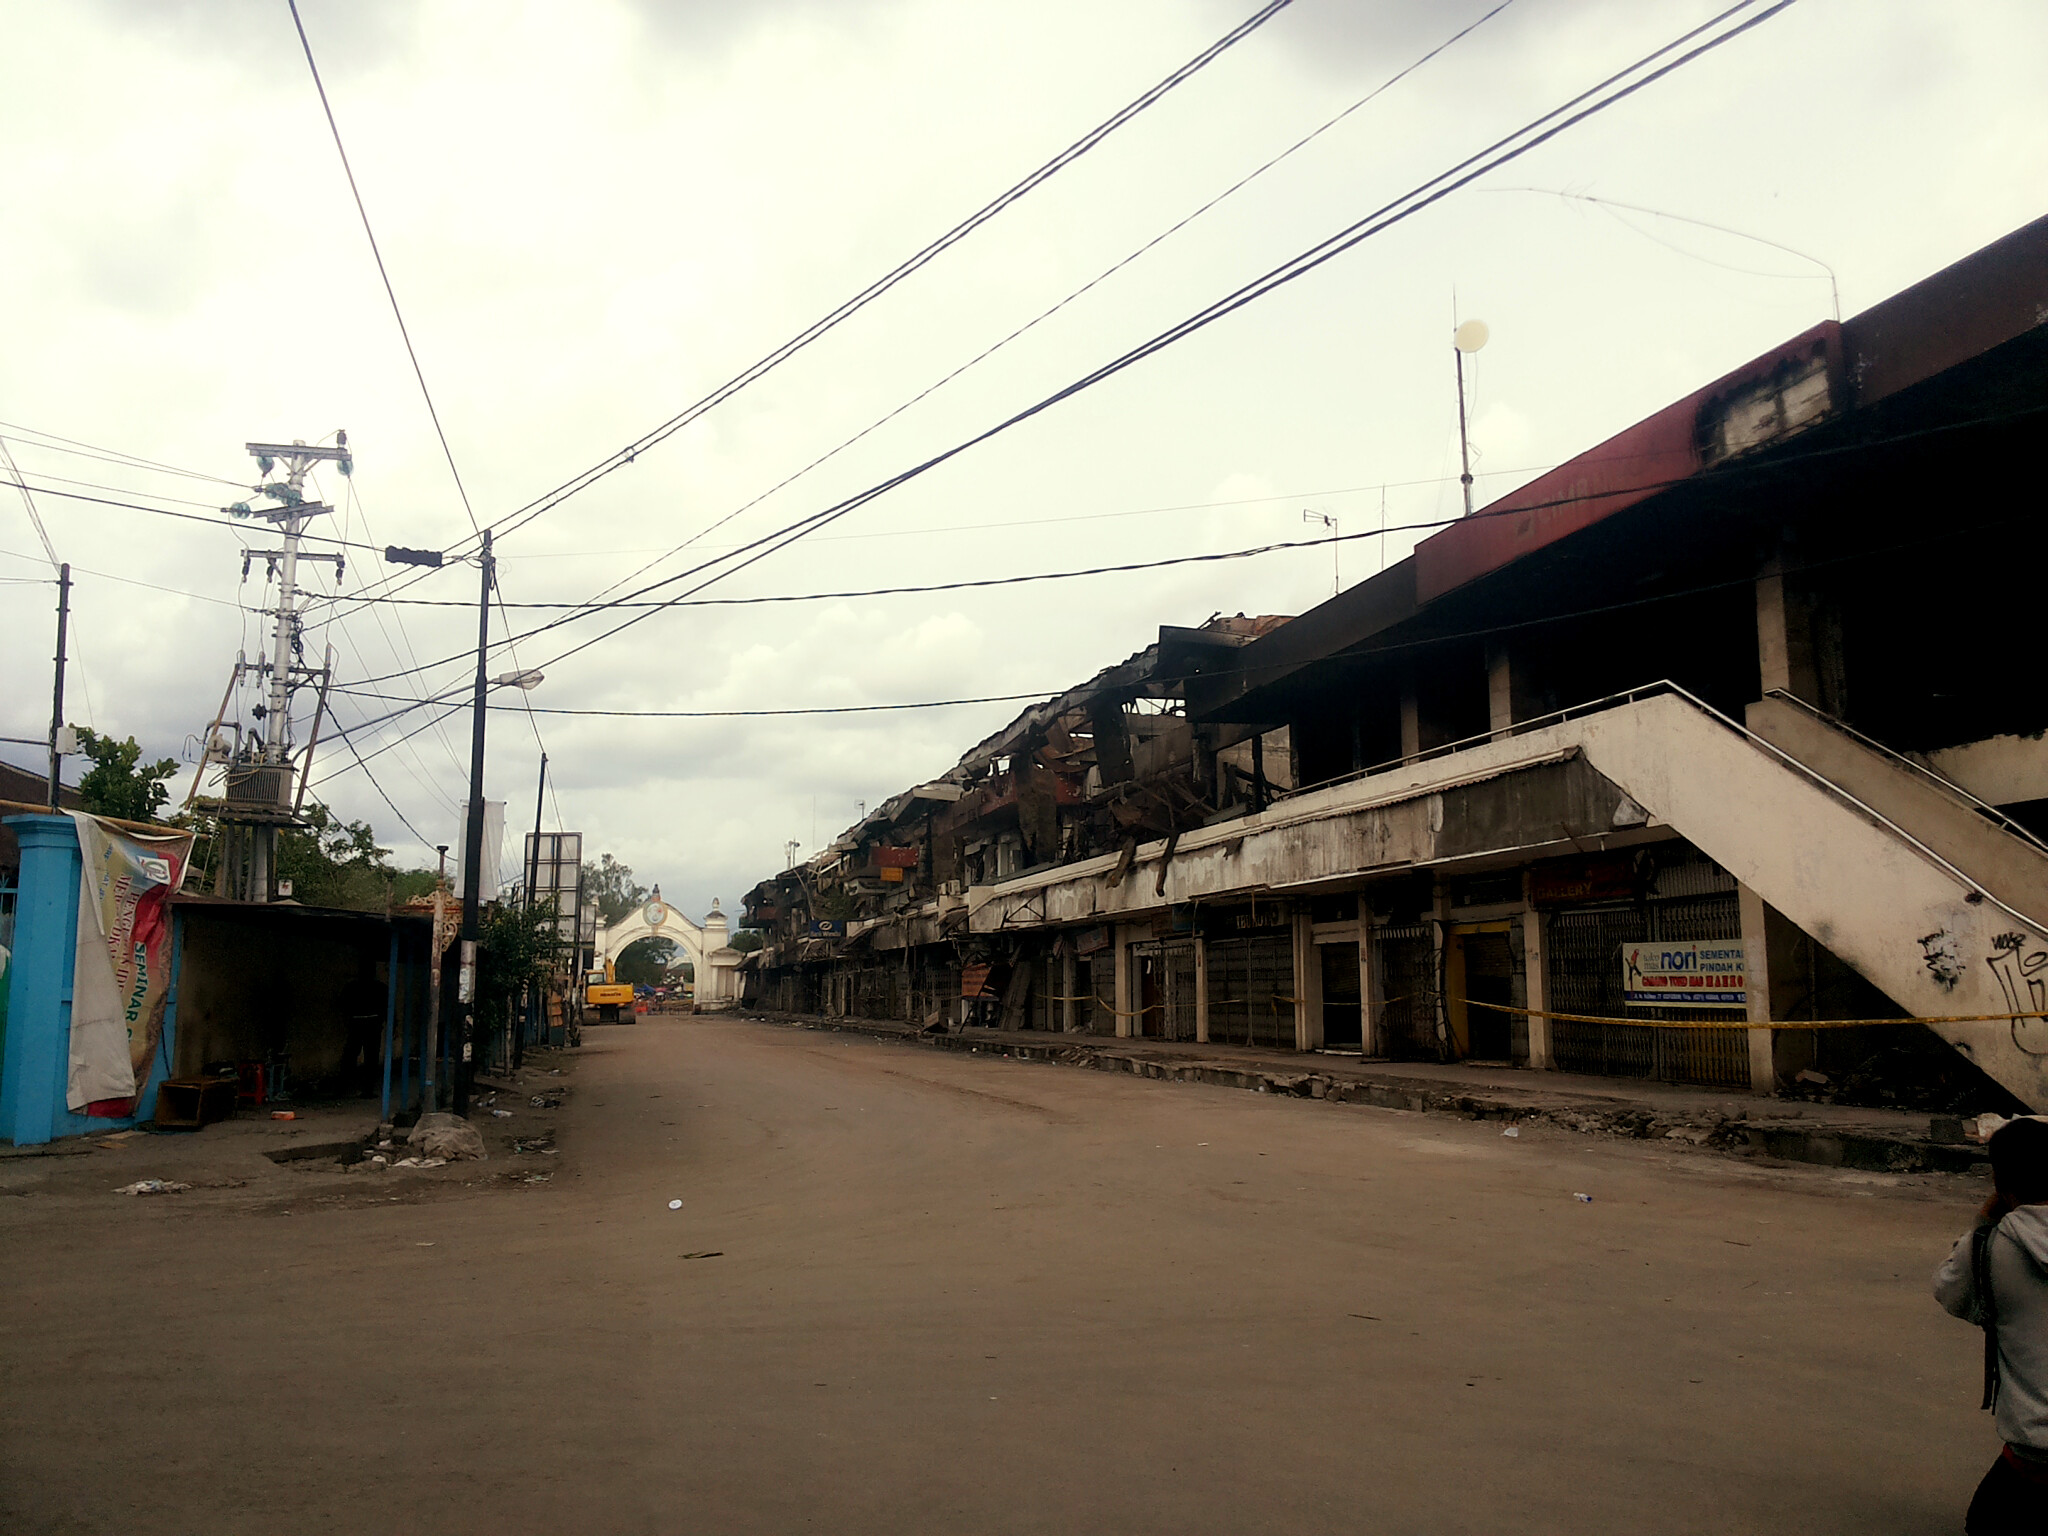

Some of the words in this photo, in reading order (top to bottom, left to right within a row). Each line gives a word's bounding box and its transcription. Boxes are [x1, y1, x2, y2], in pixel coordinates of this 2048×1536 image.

[1537, 882, 1593, 899] GALLERY
[1661, 945, 1697, 970] nori
[1699, 962, 1733, 972] PINDAH
[125, 940, 148, 1022] SEMINAR
